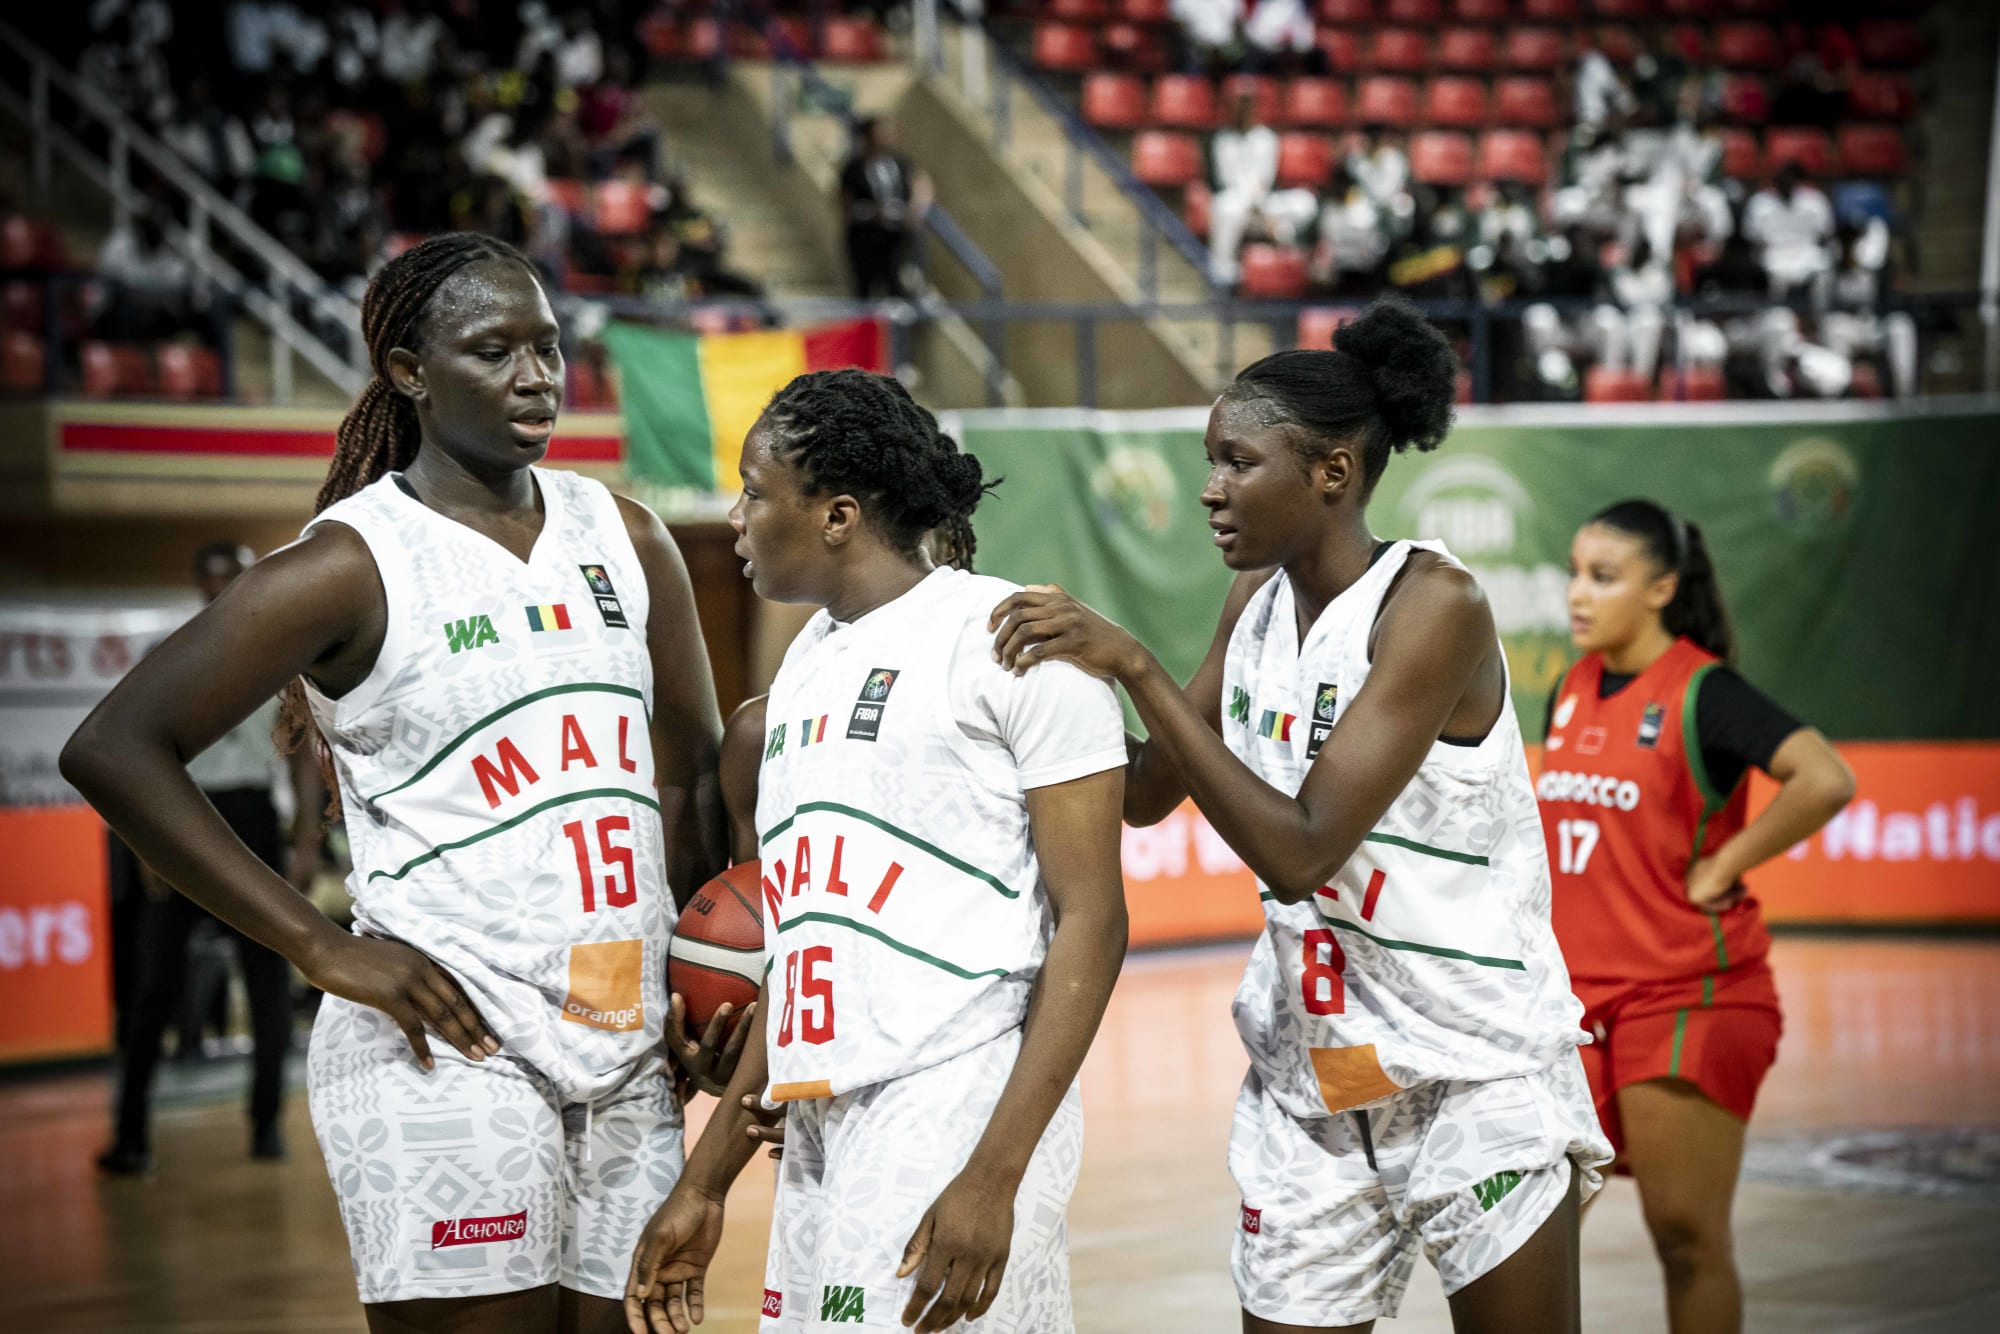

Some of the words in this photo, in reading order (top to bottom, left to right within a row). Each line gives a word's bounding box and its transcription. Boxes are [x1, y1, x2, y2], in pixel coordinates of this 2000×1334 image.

[444, 614, 500, 654] WA
[855, 707, 879, 721] FIBA
[471, 714, 657, 810] MAL
[562, 815, 638, 913] 15
[761, 834, 905, 929] MALI
[1557, 818, 1599, 874] 17
[777, 945, 835, 1048] 85
[1302, 929, 1346, 1016] 8
[567, 1002, 640, 1029] orange
[821, 1285, 866, 1323] WA
